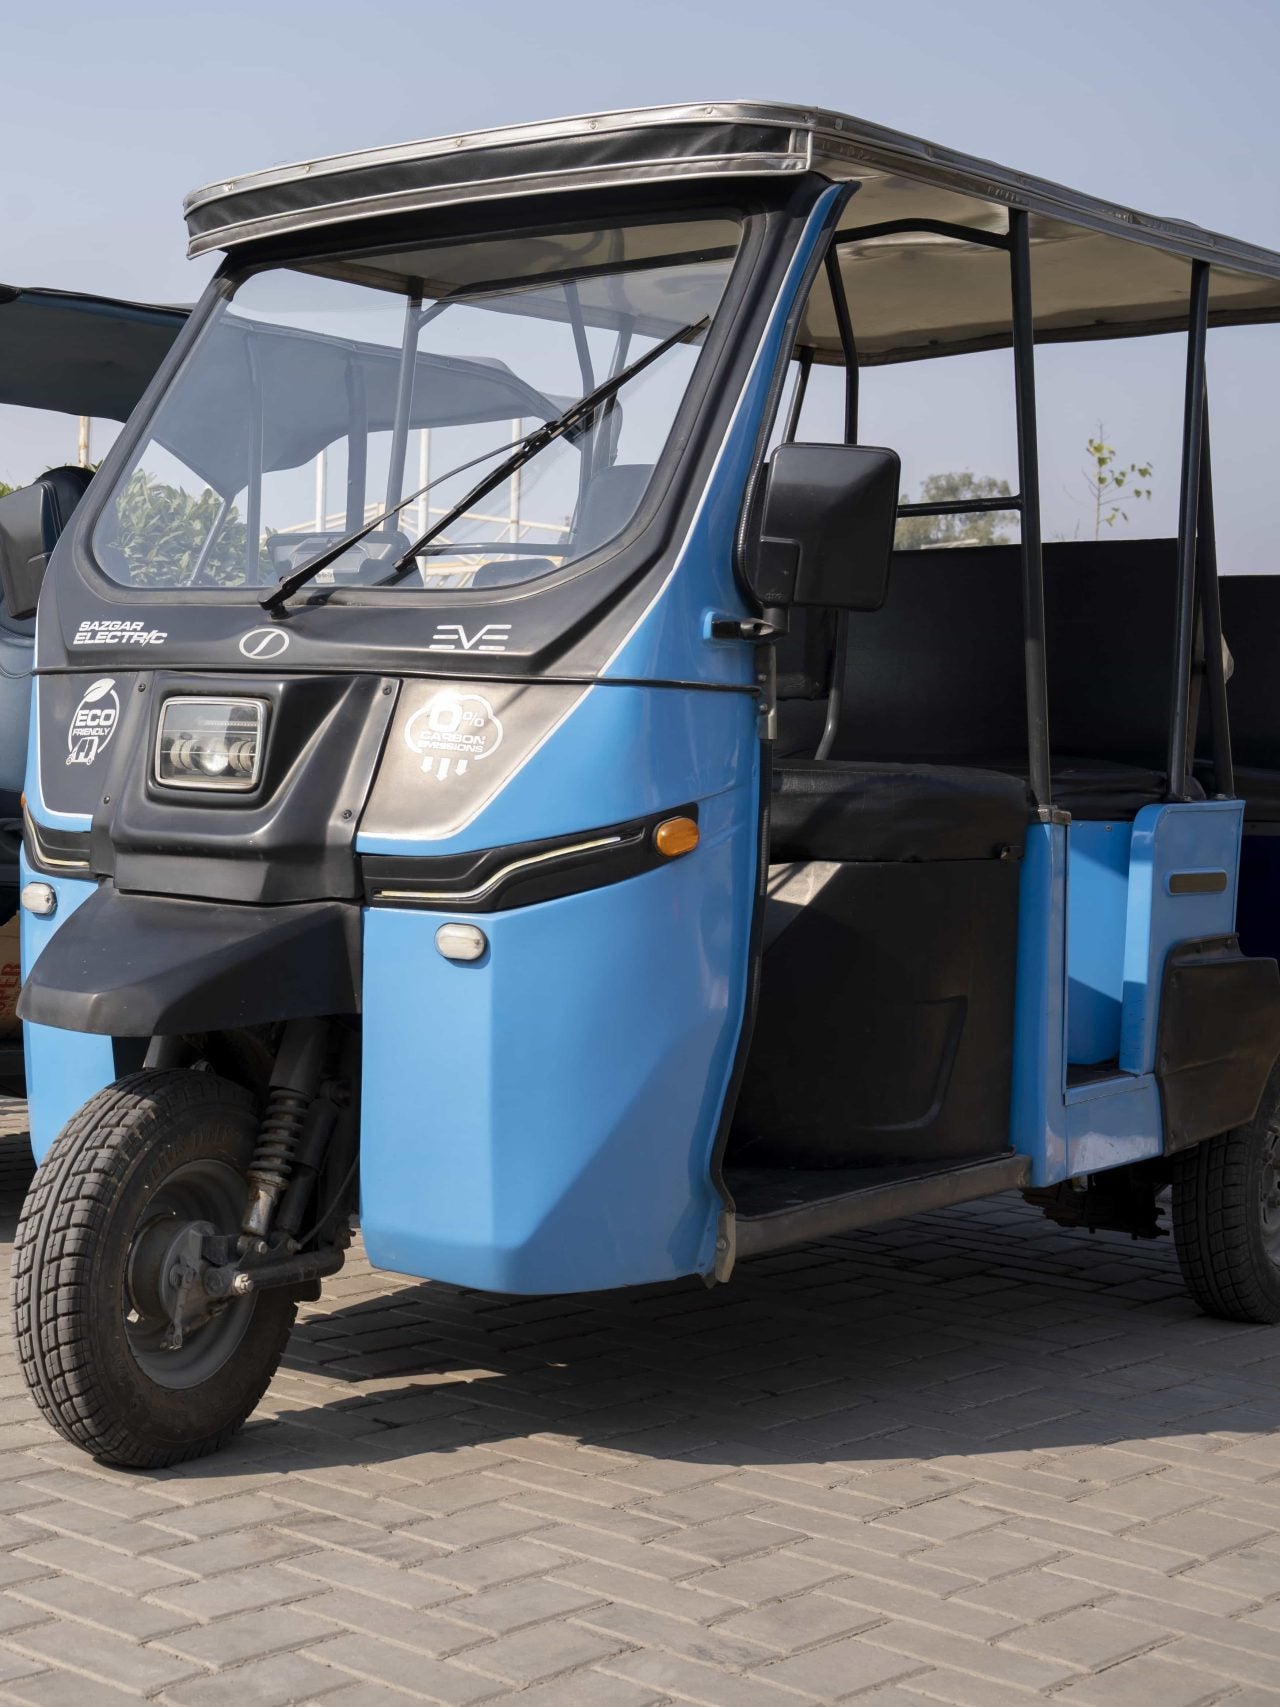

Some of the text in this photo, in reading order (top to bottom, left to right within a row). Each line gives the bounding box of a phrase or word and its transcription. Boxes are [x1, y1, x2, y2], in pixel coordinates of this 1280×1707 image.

[78, 620, 145, 631] SAZGAR
[72, 630, 168, 647] ELECTRIC
[75, 709, 116, 727] ECO
[72, 727, 111, 736] FRIENDLY
[419, 730, 487, 744] CARBON
